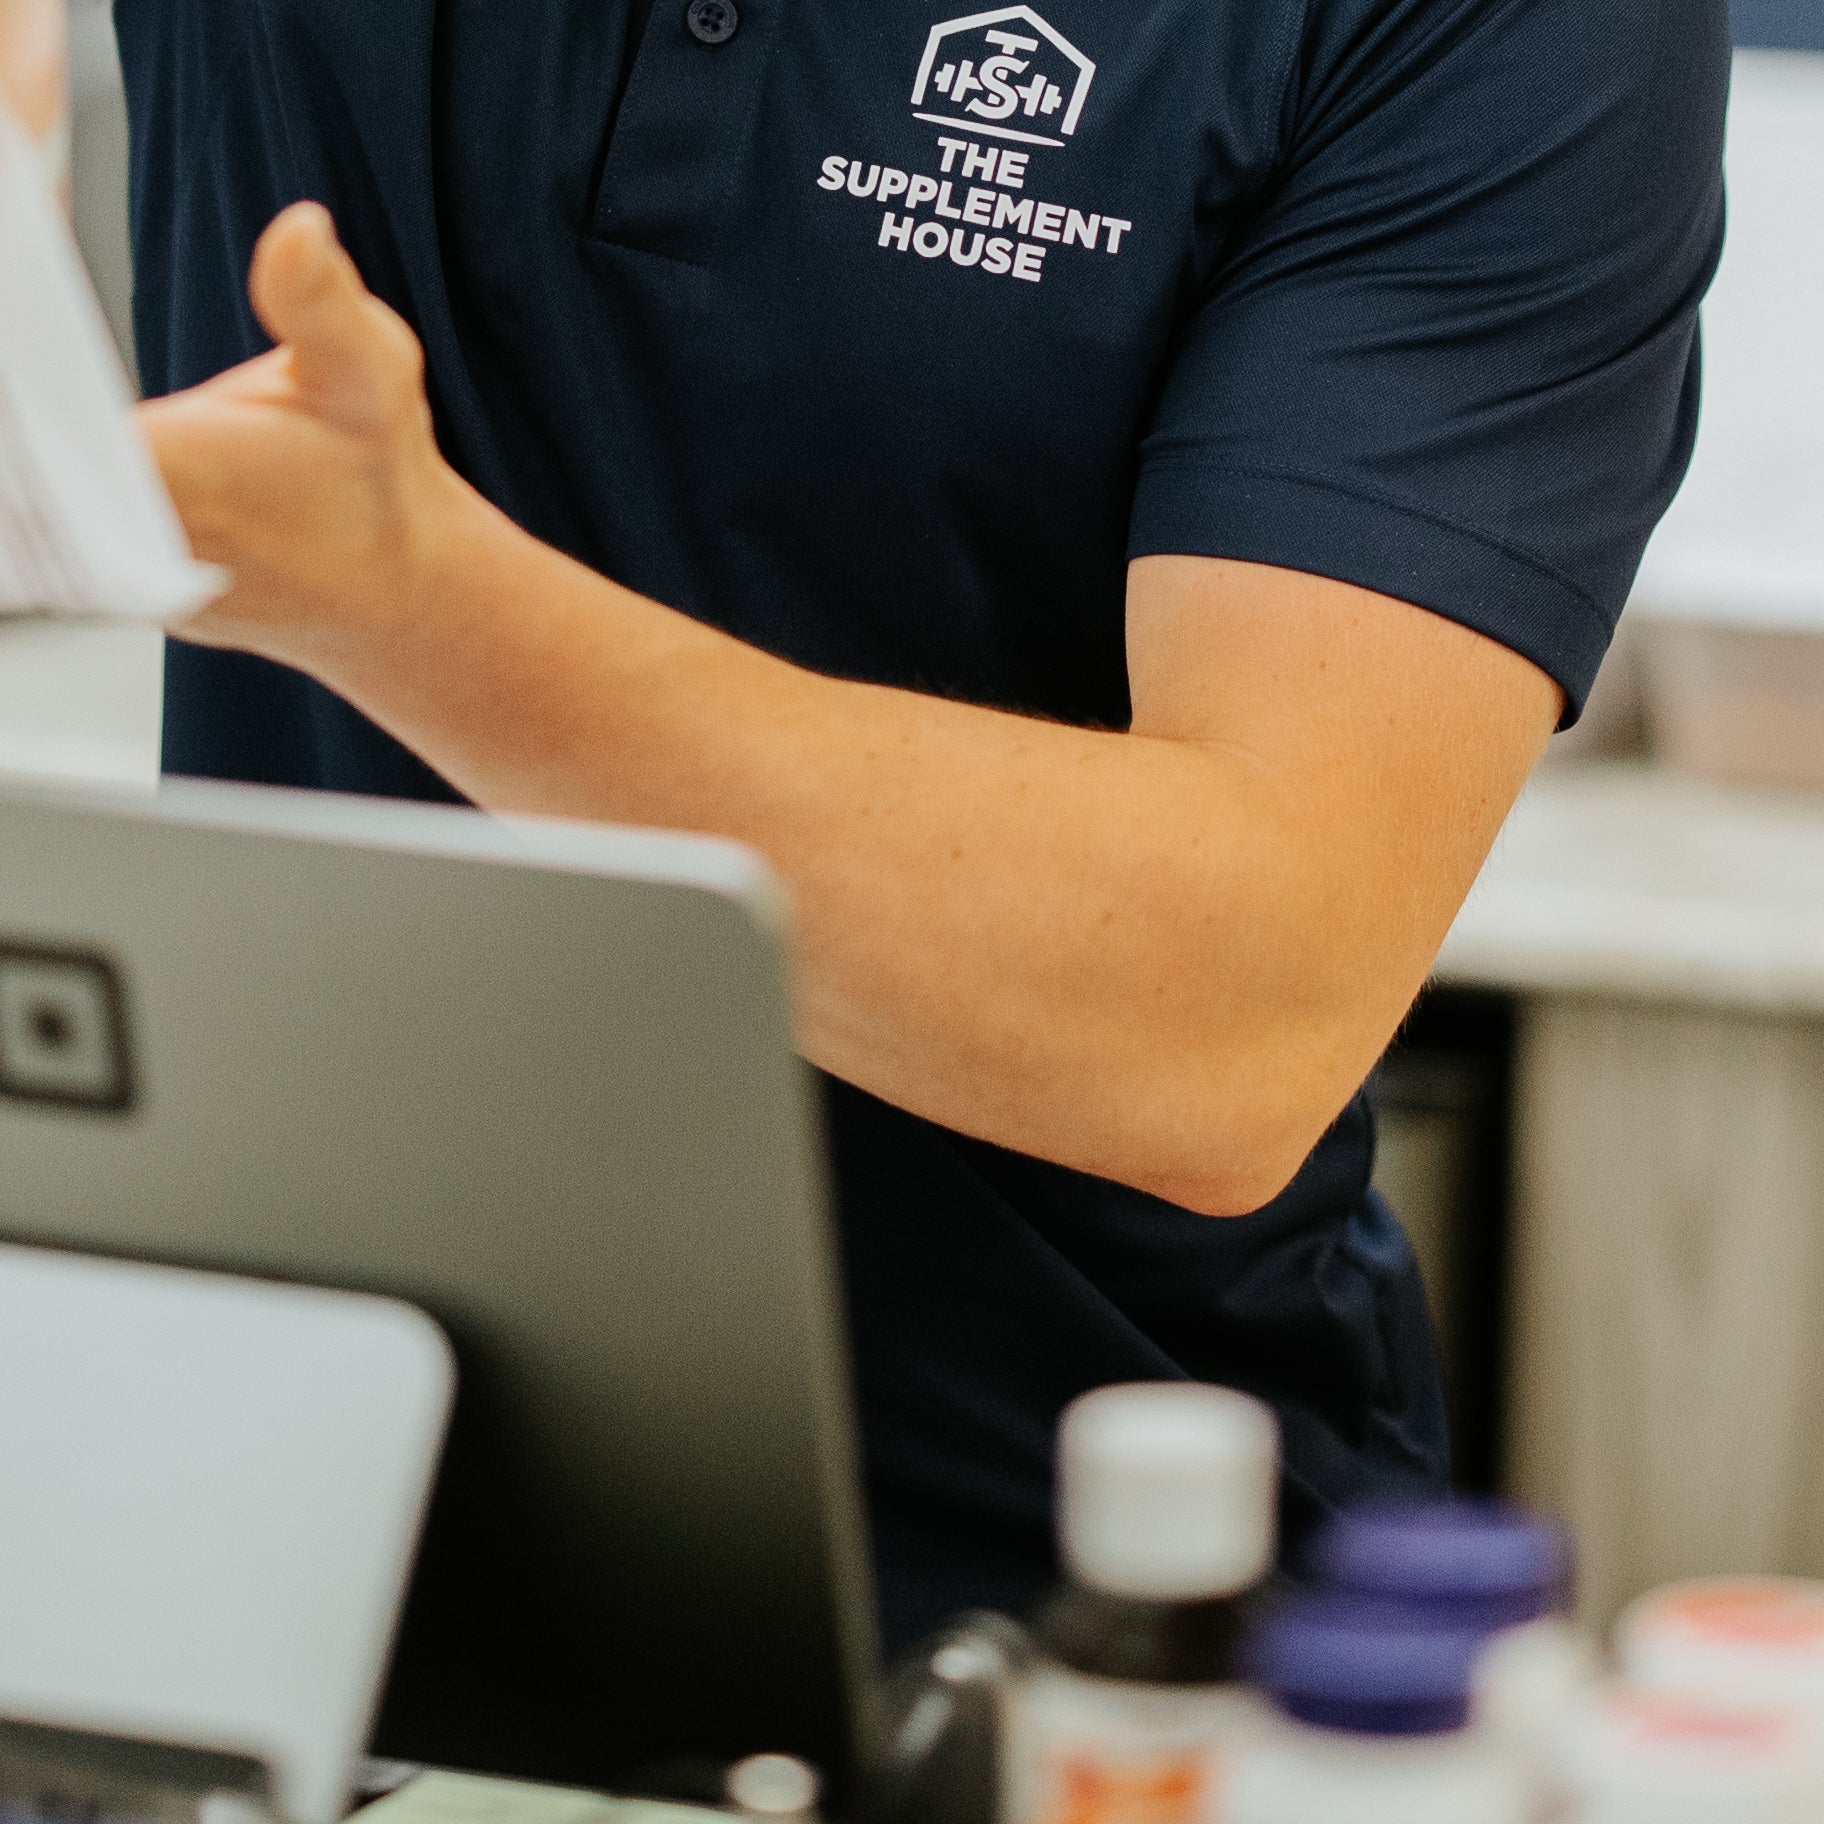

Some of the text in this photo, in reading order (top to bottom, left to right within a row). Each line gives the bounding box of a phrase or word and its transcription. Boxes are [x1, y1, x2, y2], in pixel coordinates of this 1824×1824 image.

[938, 136, 1029, 189] THE
[817, 156, 1132, 254] SUPPLEMENT
[878, 212, 1046, 282] HOUSE
